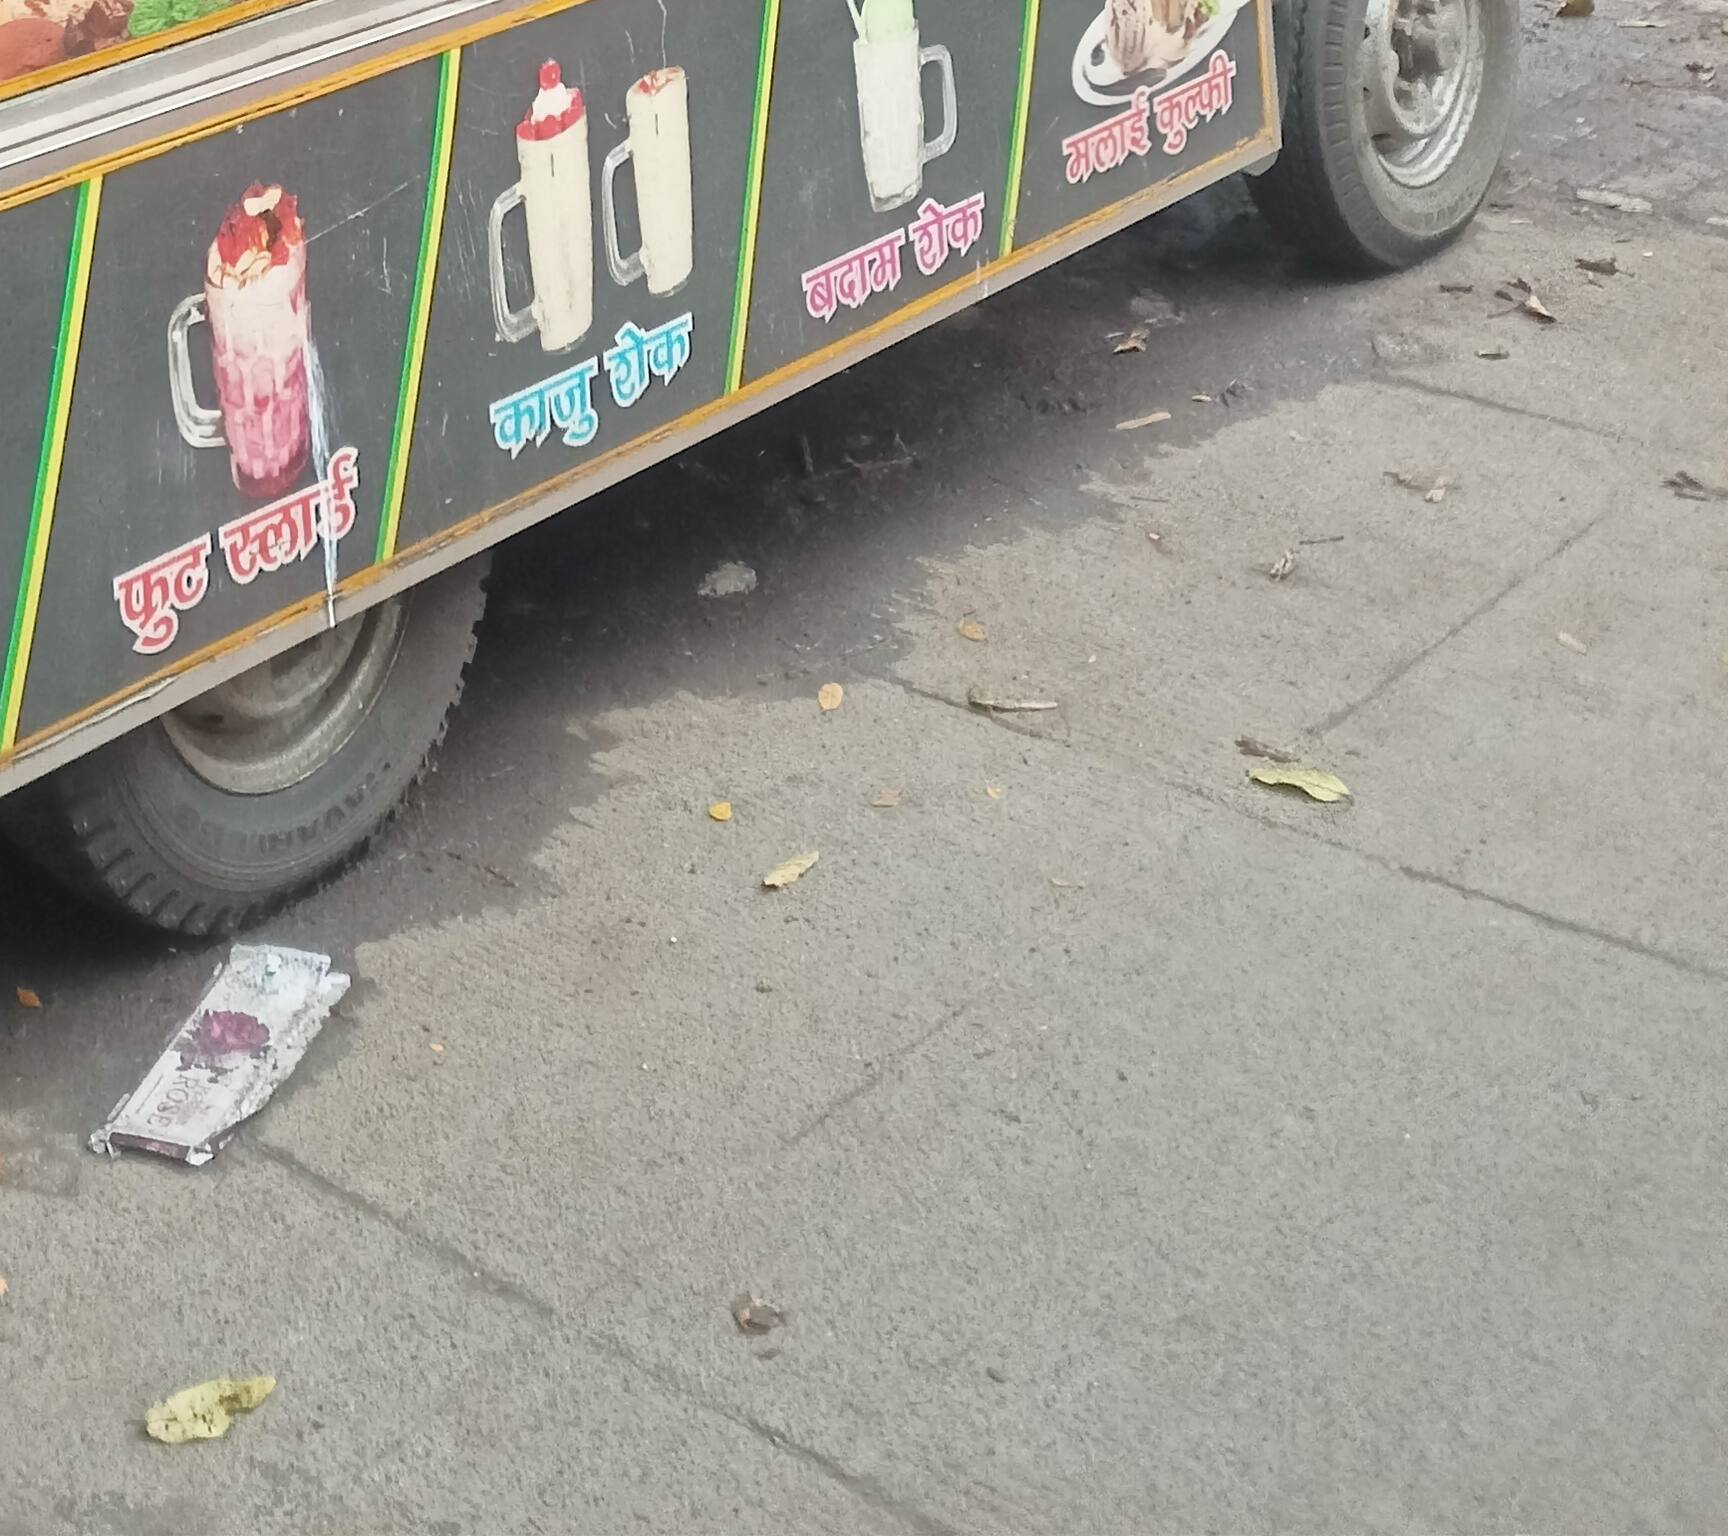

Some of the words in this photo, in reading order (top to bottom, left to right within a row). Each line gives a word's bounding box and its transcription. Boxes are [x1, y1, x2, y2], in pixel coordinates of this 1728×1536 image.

[1061, 84, 1153, 185] मलाई
[1154, 48, 1237, 155] कुल्फी
[801, 227, 906, 324] बदाम
[909, 192, 985, 276] शेक
[489, 353, 600, 459] काजु
[604, 310, 693, 408] शेक
